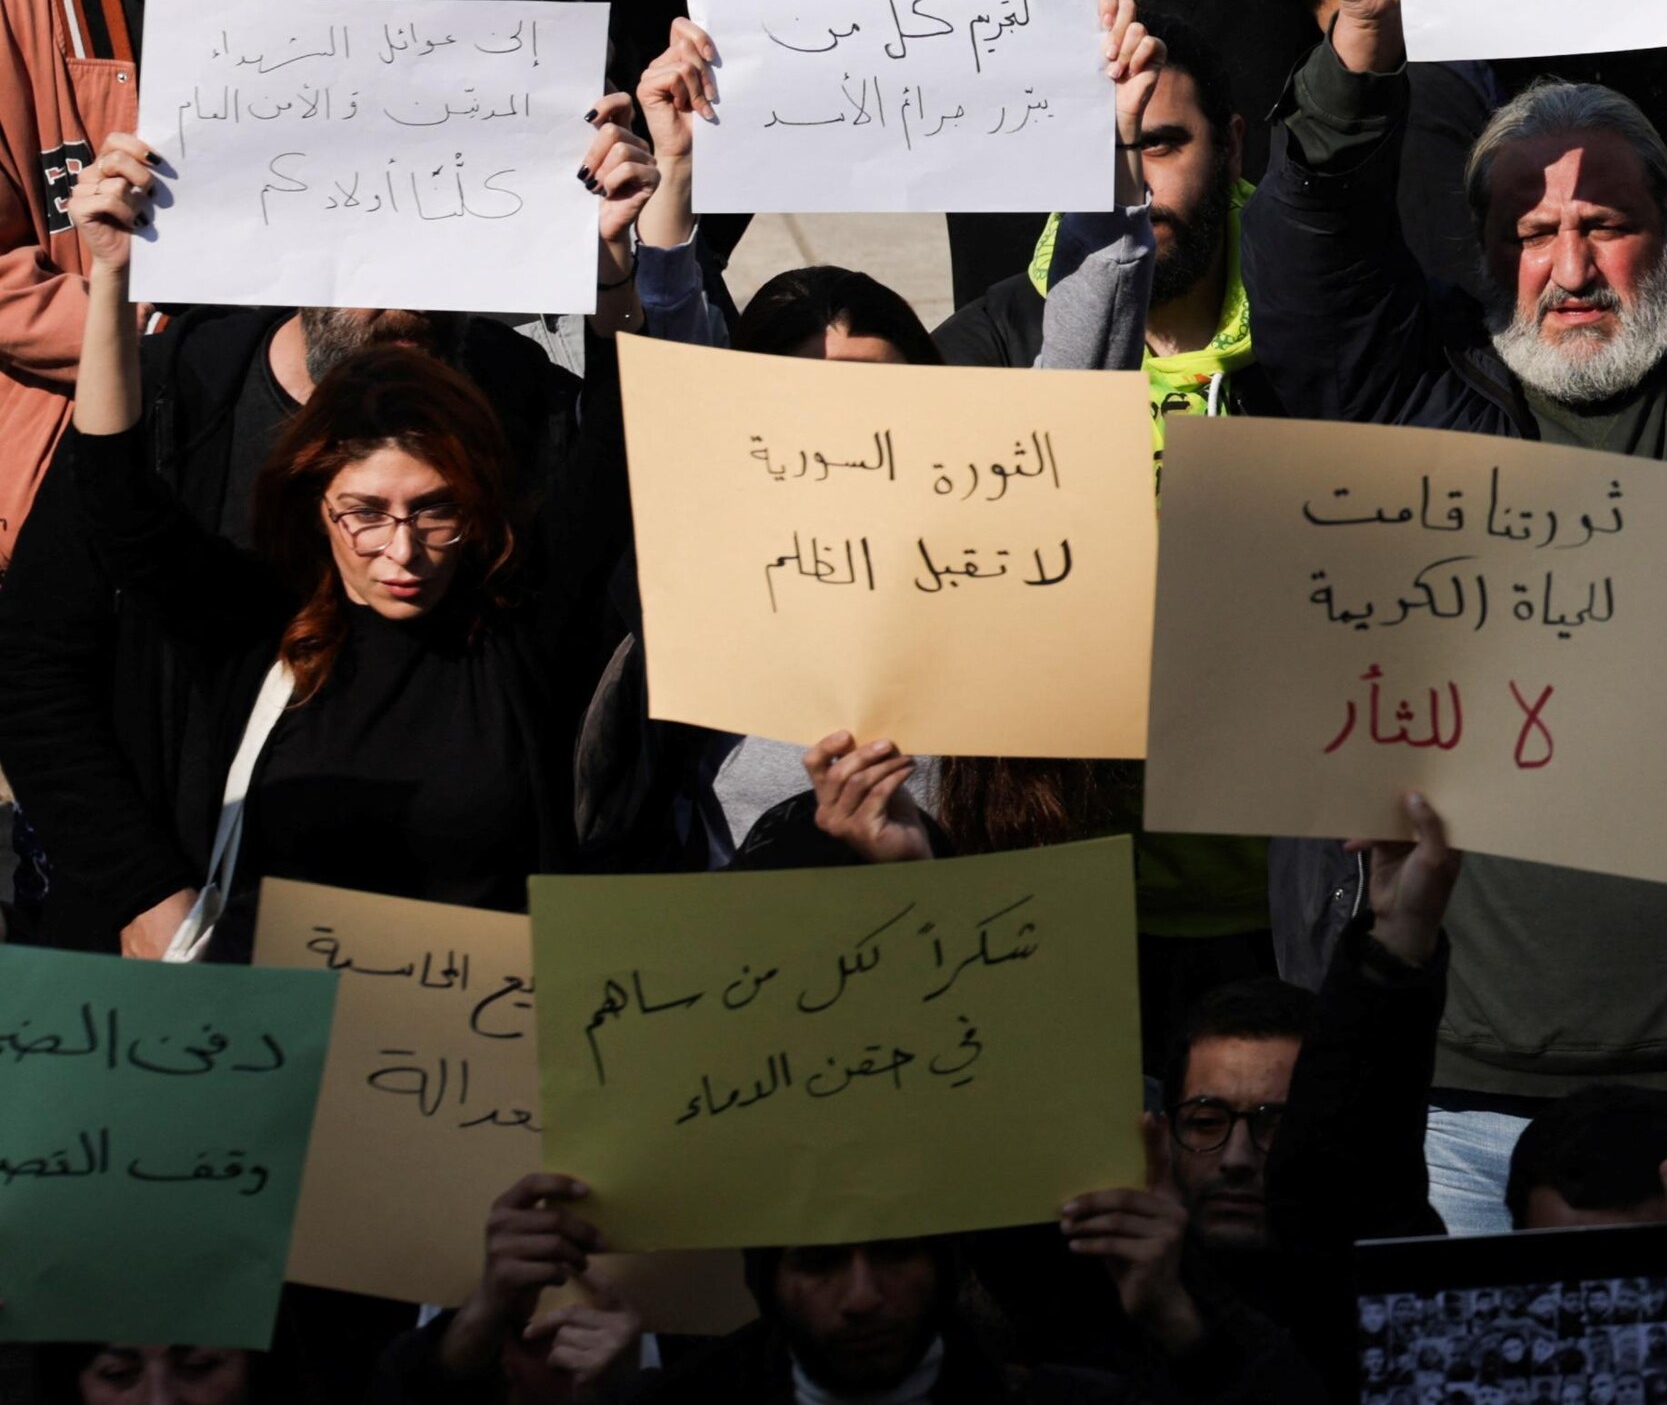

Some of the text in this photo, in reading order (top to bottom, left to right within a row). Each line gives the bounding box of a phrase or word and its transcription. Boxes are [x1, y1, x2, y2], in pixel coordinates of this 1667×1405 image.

[211, 25, 350, 74] الشهداء
[378, 22, 457, 64] عوائل
[761, 16, 860, 53] من
[178, 85, 239, 158] العام
[247, 84, 331, 120] الأمن
[764, 72, 886, 128] الأسد
[749, 429, 1061, 502] الثورة السورية
[1302, 466, 1624, 550] ثورتنا قامت
[766, 530, 1073, 614] لا تقبل الظلم
[1309, 555, 1616, 640] للحياة الكريمة
[1322, 663, 1555, 769] لا للثأر
[723, 965, 780, 1010] من
[584, 970, 705, 1087] ساهم
[928, 1015, 985, 1088] في
[367, 1049, 543, 1128] عدالة
